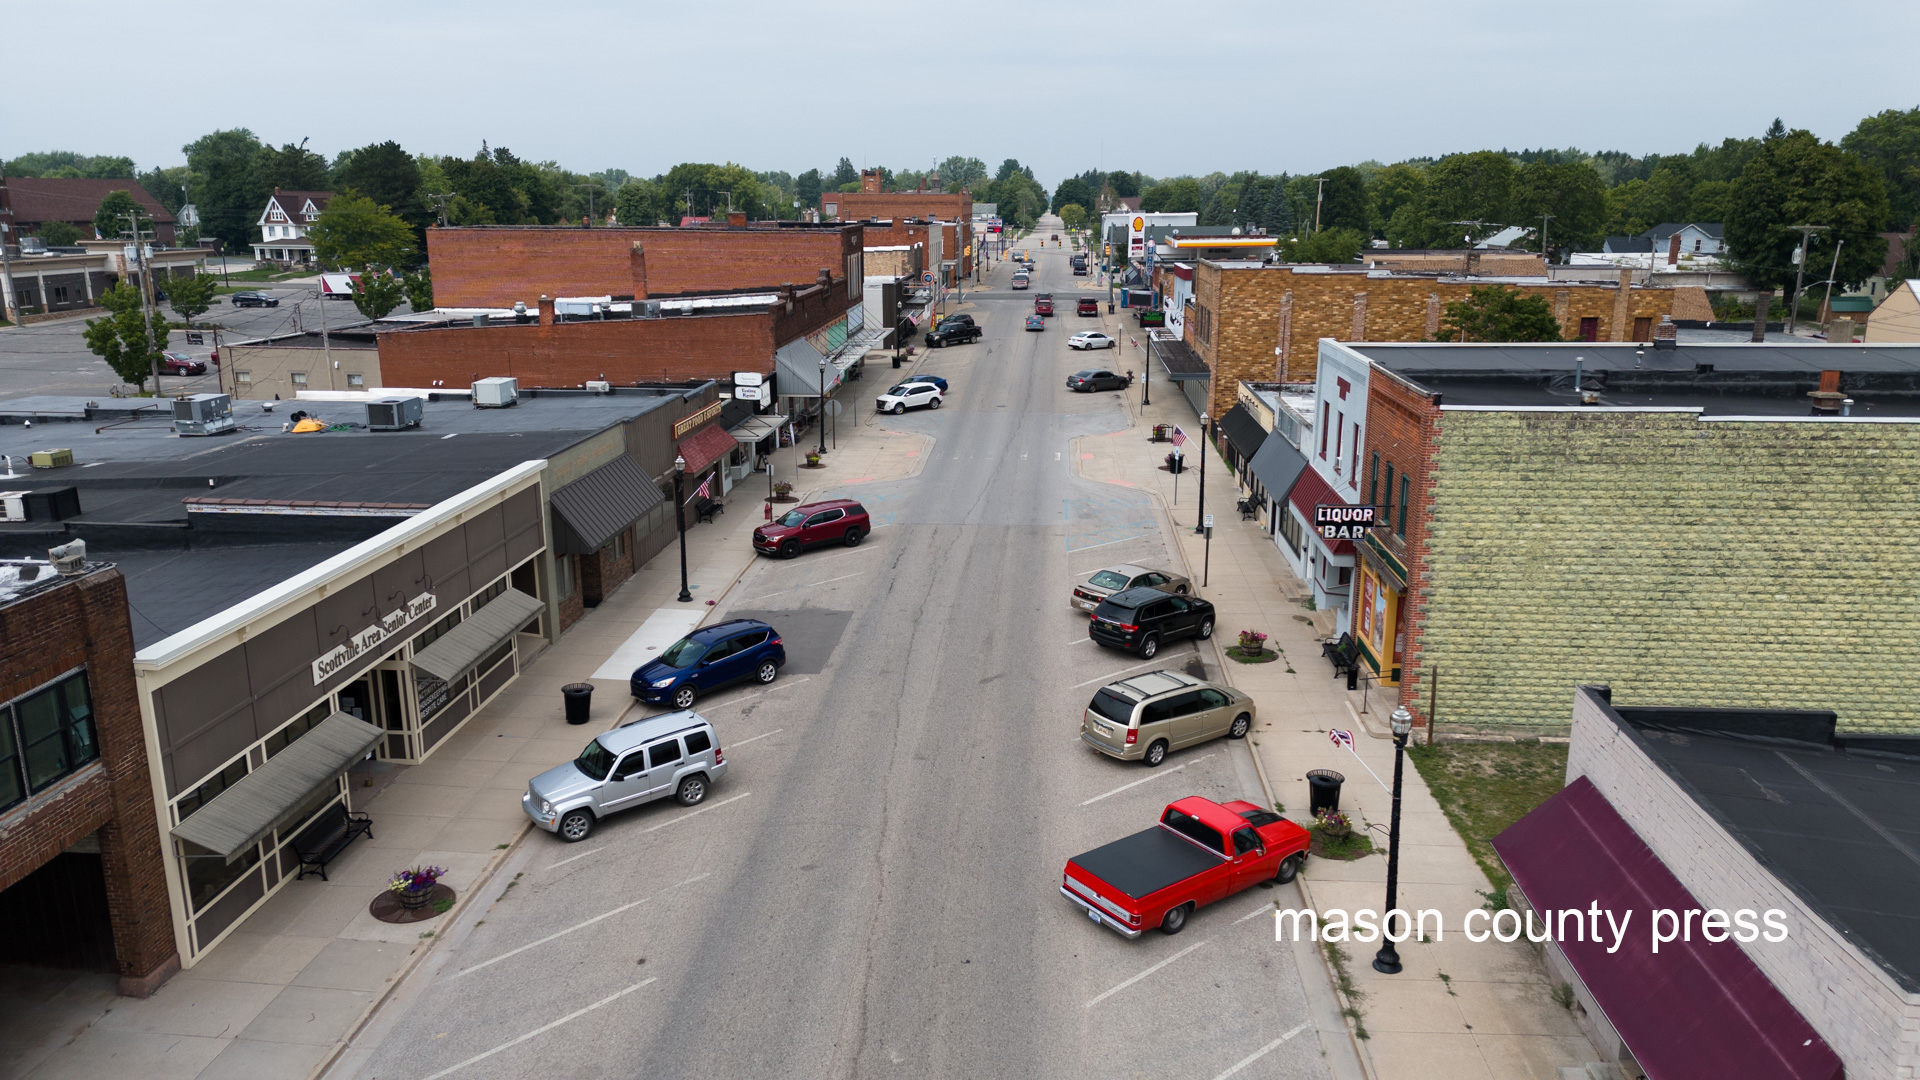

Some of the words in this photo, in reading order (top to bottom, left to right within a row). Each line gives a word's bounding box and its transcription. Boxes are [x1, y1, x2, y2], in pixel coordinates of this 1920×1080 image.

[677, 420, 692, 435] GREAT
[692, 414, 704, 429] FOOD
[706, 404, 722, 419] SPIRITS
[1318, 508, 1373, 523] LIQUOR
[1324, 525, 1364, 539] BAR
[318, 642, 360, 679] Scottville
[361, 629, 381, 652] Area
[383, 612, 407, 637] Senior
[409, 596, 433, 619] Center
[420, 701, 437, 719] RESPITE
[436, 693, 448, 706] CARE
